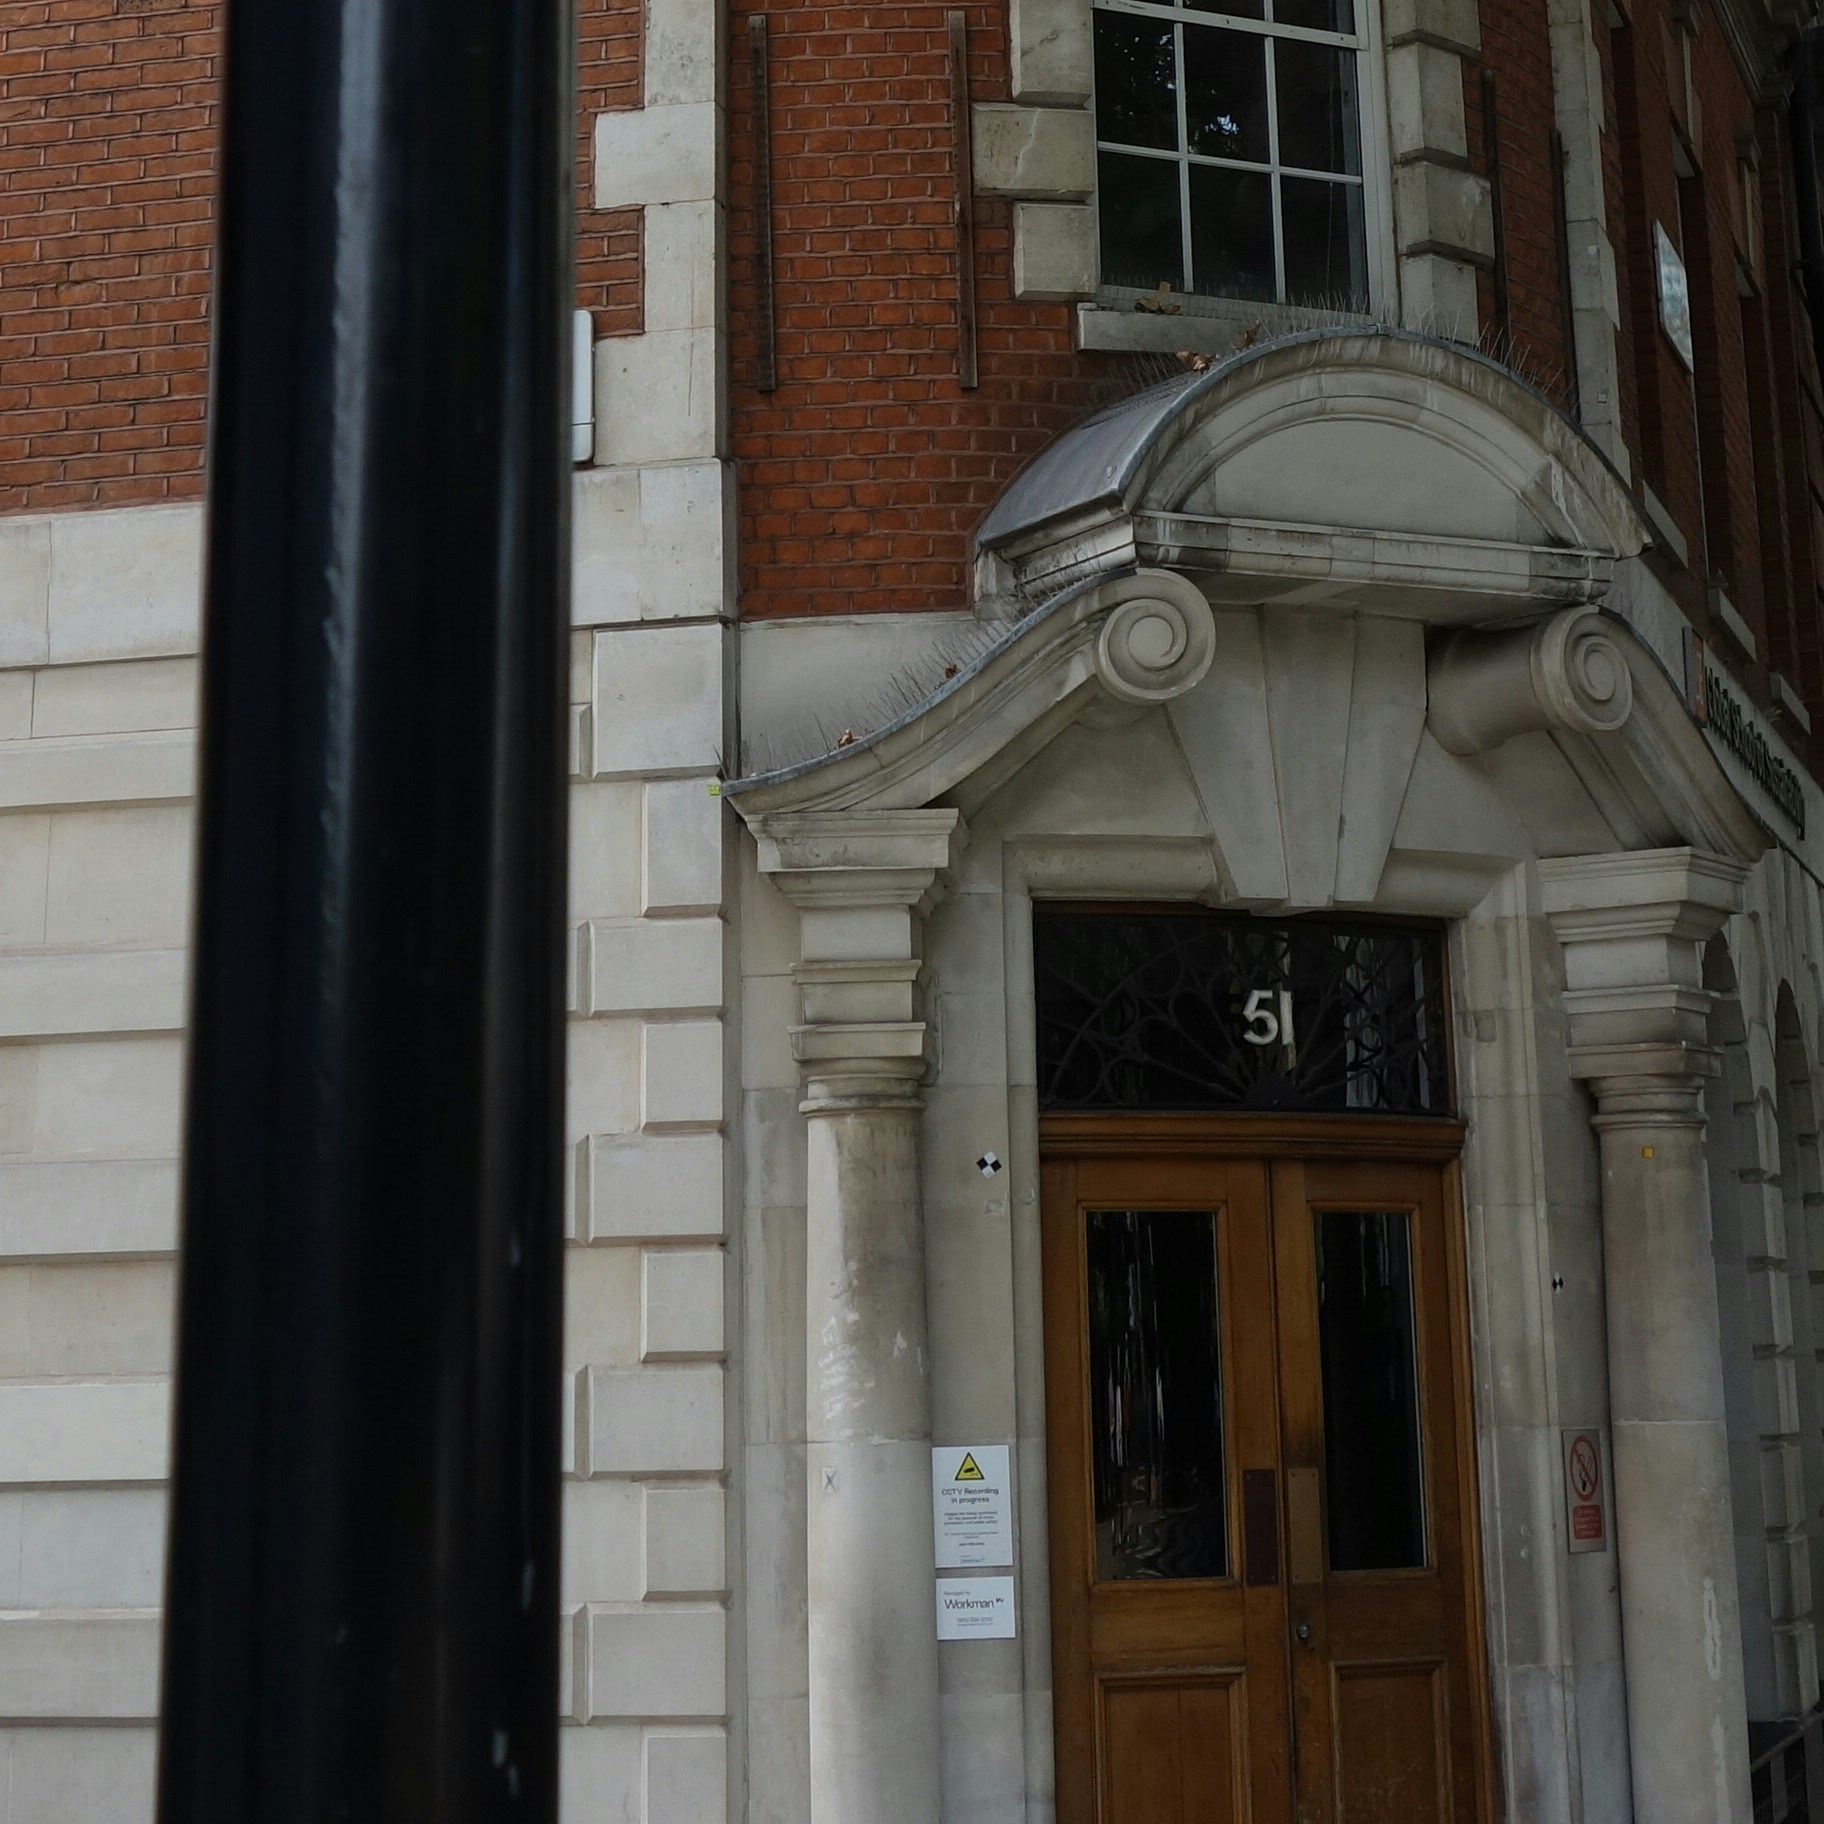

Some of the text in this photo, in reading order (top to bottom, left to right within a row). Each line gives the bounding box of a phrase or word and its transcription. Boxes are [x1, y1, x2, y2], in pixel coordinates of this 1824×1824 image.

[1242, 989, 1295, 1046] 51
[941, 1487, 999, 1496] CCTV Recording
[959, 1496, 990, 1504] progress
[944, 1598, 994, 1610] Workman
